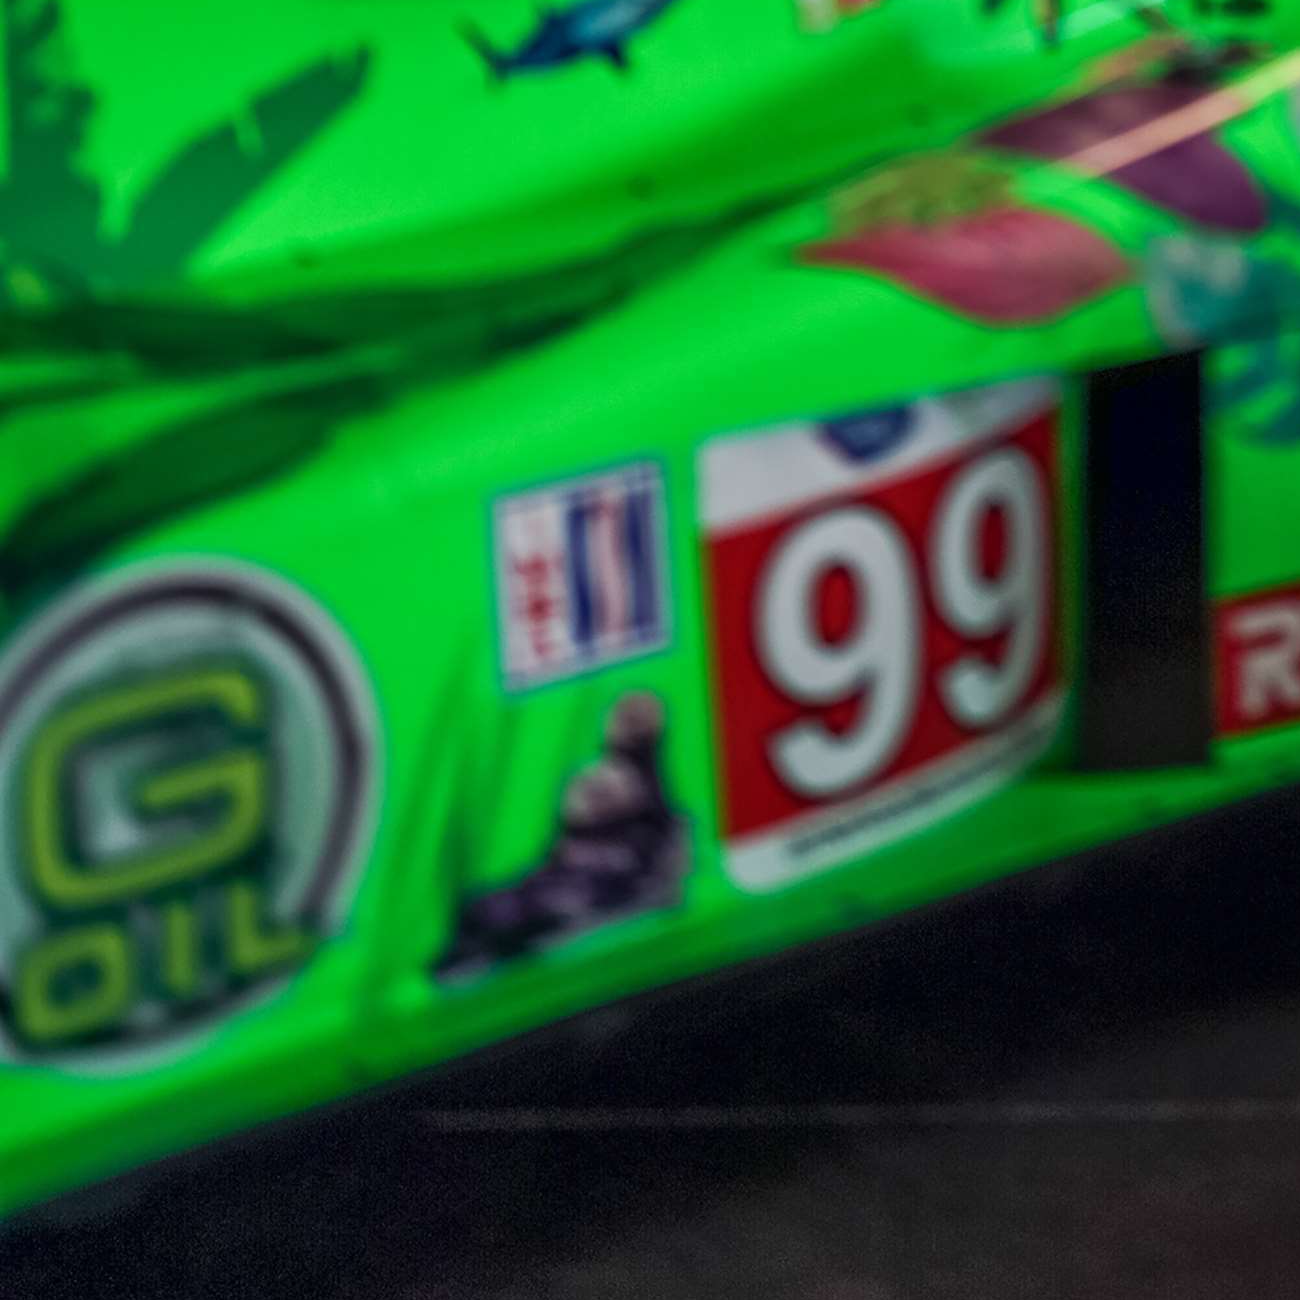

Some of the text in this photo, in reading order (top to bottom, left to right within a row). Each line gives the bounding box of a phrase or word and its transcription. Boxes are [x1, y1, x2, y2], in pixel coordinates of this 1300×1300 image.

[755, 445, 1045, 796] 99
[26, 668, 264, 902] G
[18, 884, 312, 1042] OIL
